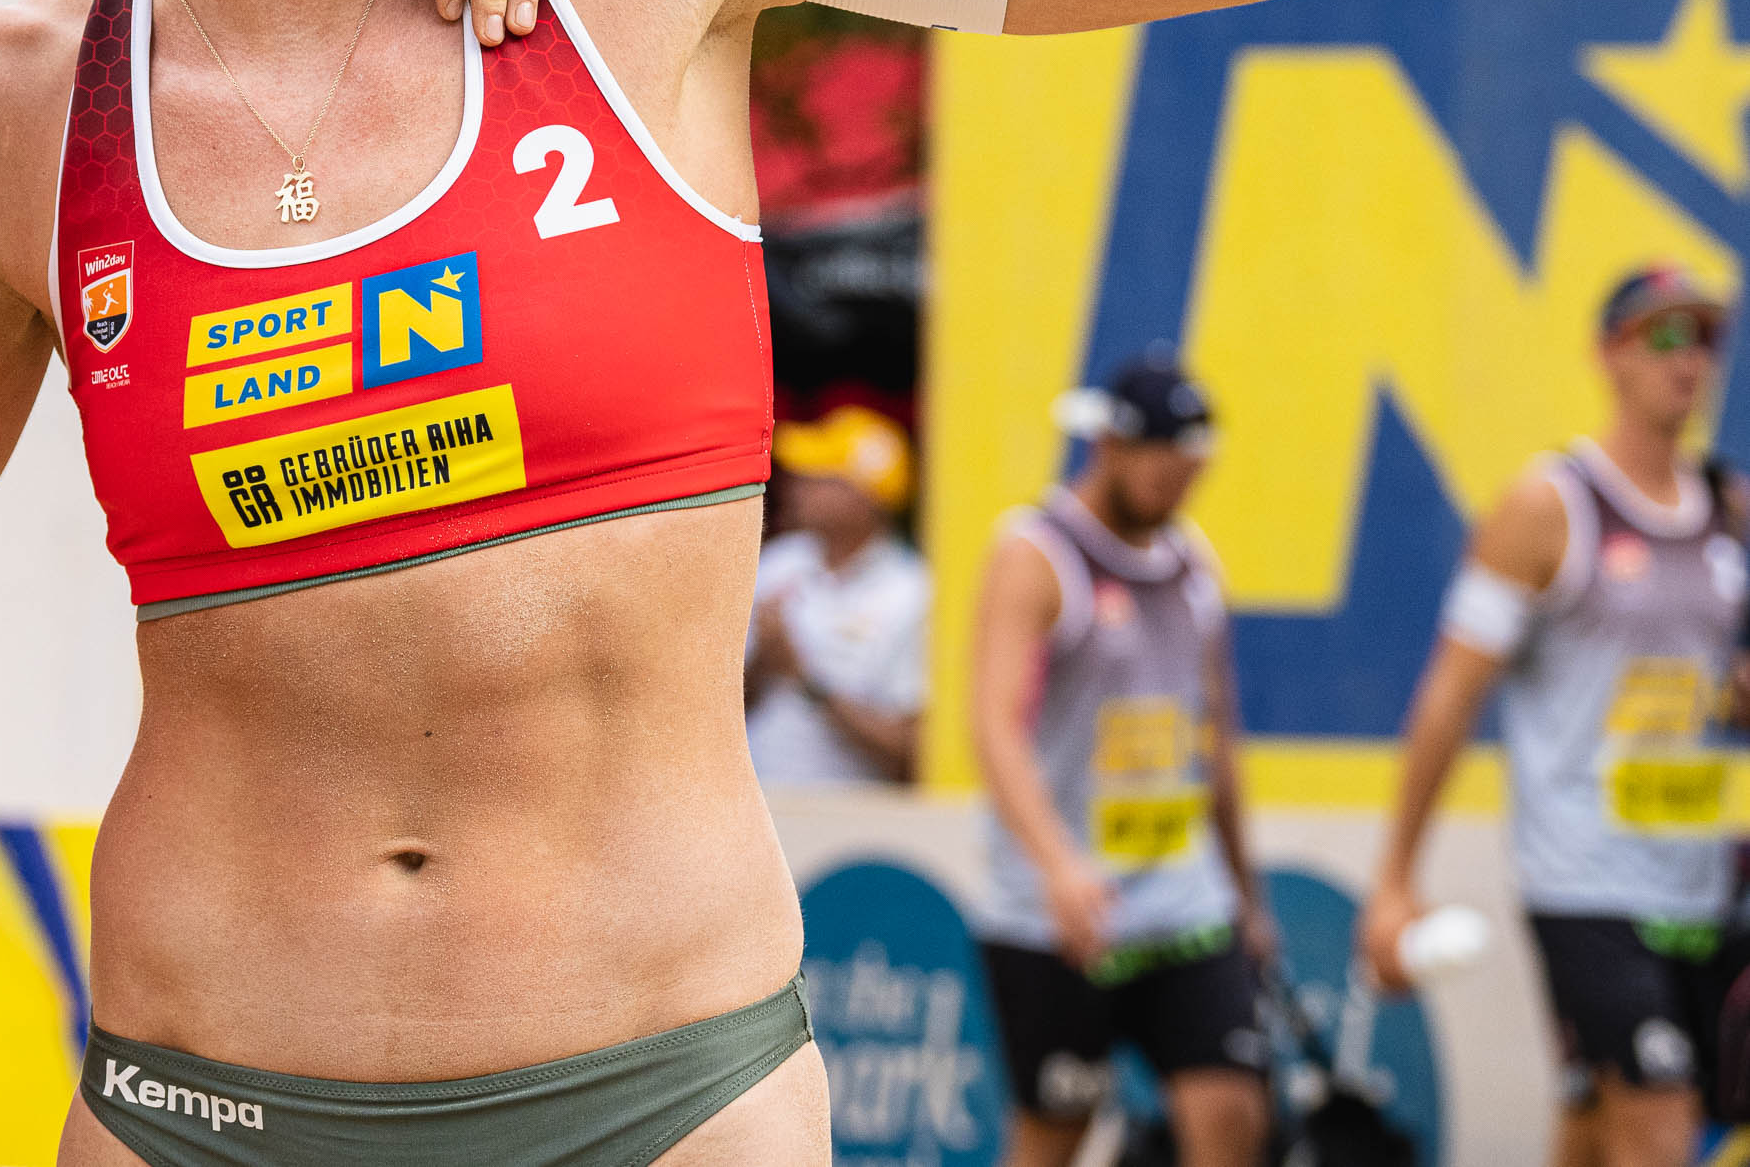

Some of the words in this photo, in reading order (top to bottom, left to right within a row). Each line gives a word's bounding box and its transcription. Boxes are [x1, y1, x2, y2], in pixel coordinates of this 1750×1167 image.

[274, 171, 320, 224] 福
[513, 124, 620, 240] 2
[206, 300, 333, 349] SPORT
[378, 288, 464, 367] N
[214, 365, 321, 409] LAND
[279, 428, 419, 486] GEBRÜDER
[426, 413, 494, 451] RIHA
[289, 454, 451, 517] IMMOBILIEN
[102, 1058, 264, 1132] Kempa
